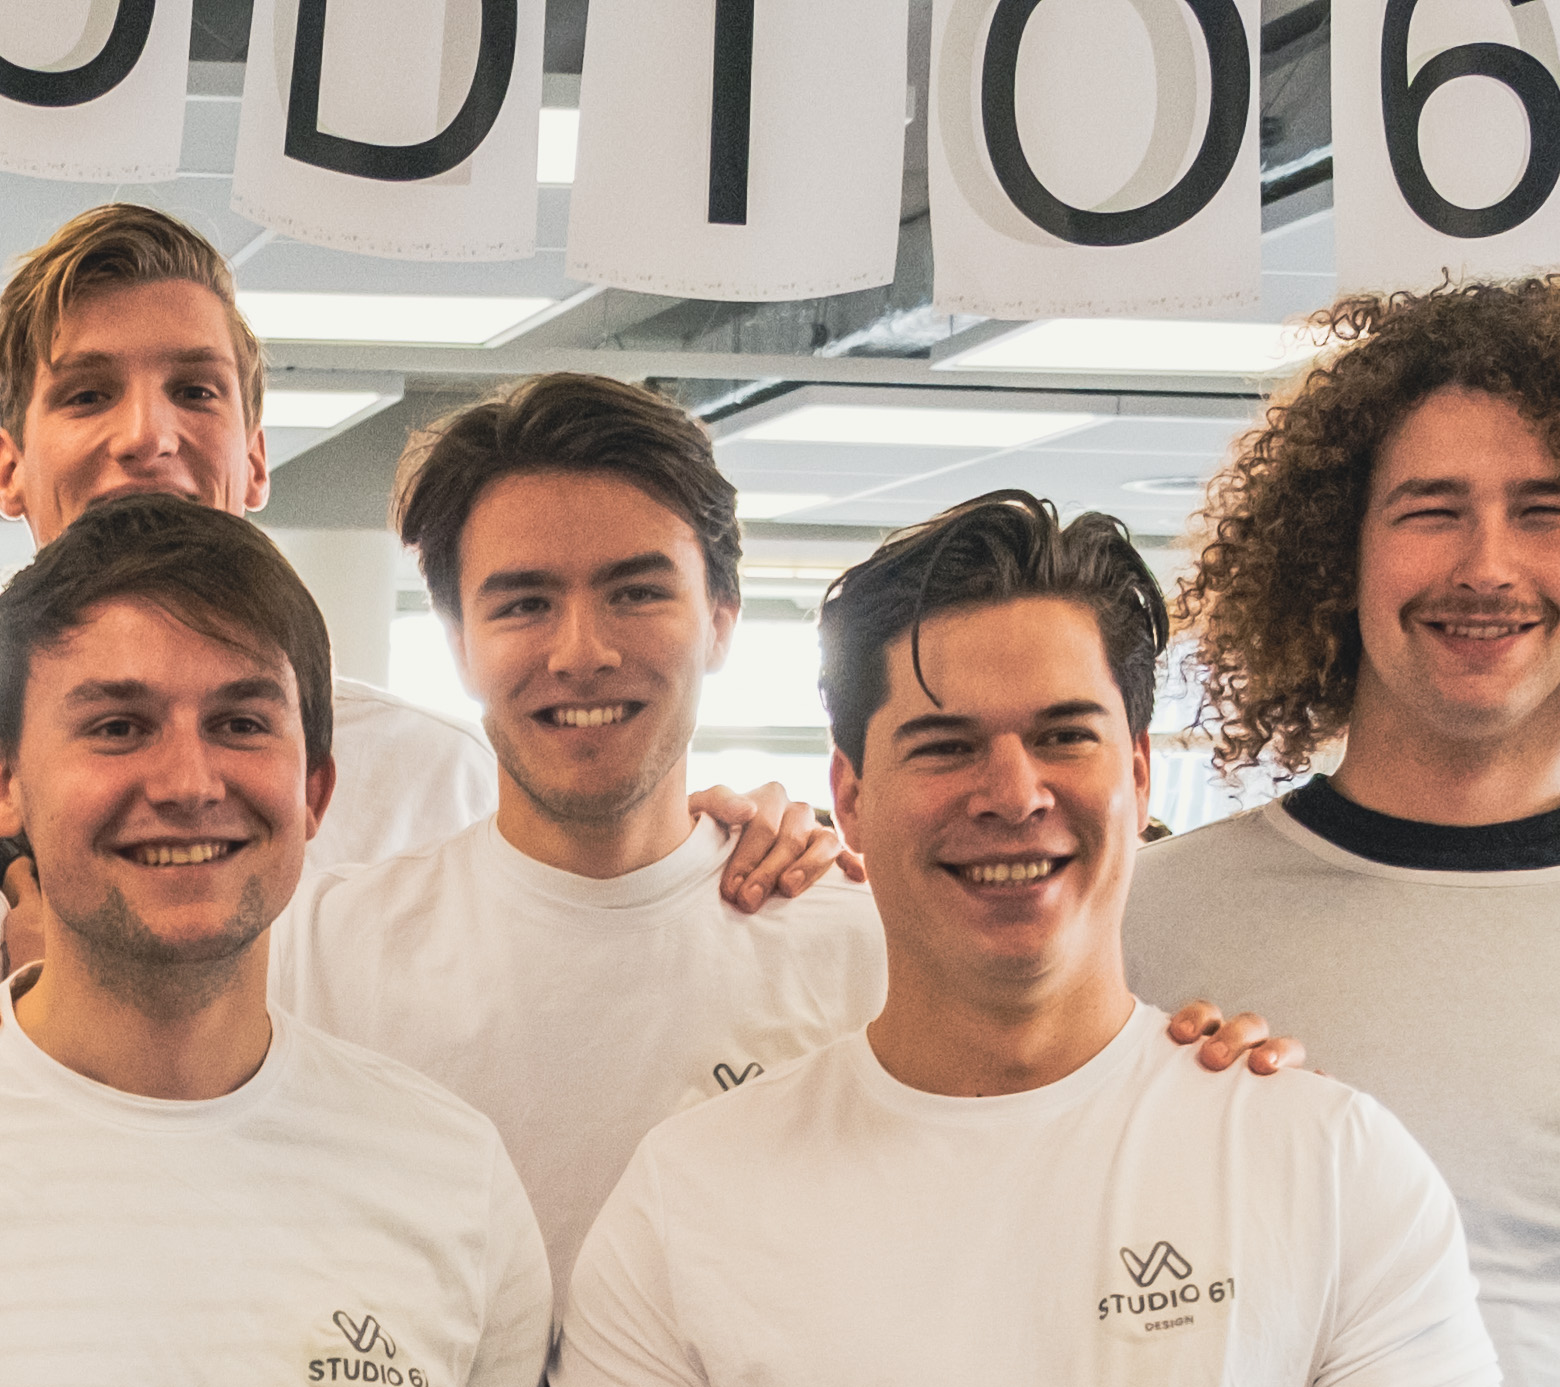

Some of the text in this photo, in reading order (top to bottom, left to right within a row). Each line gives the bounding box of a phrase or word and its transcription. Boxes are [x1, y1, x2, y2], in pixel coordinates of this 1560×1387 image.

[1098, 1277, 1235, 1320] STUDIO 61
[1145, 1315, 1194, 1331] DESIGN
[308, 1357, 404, 1386] STUDIO
